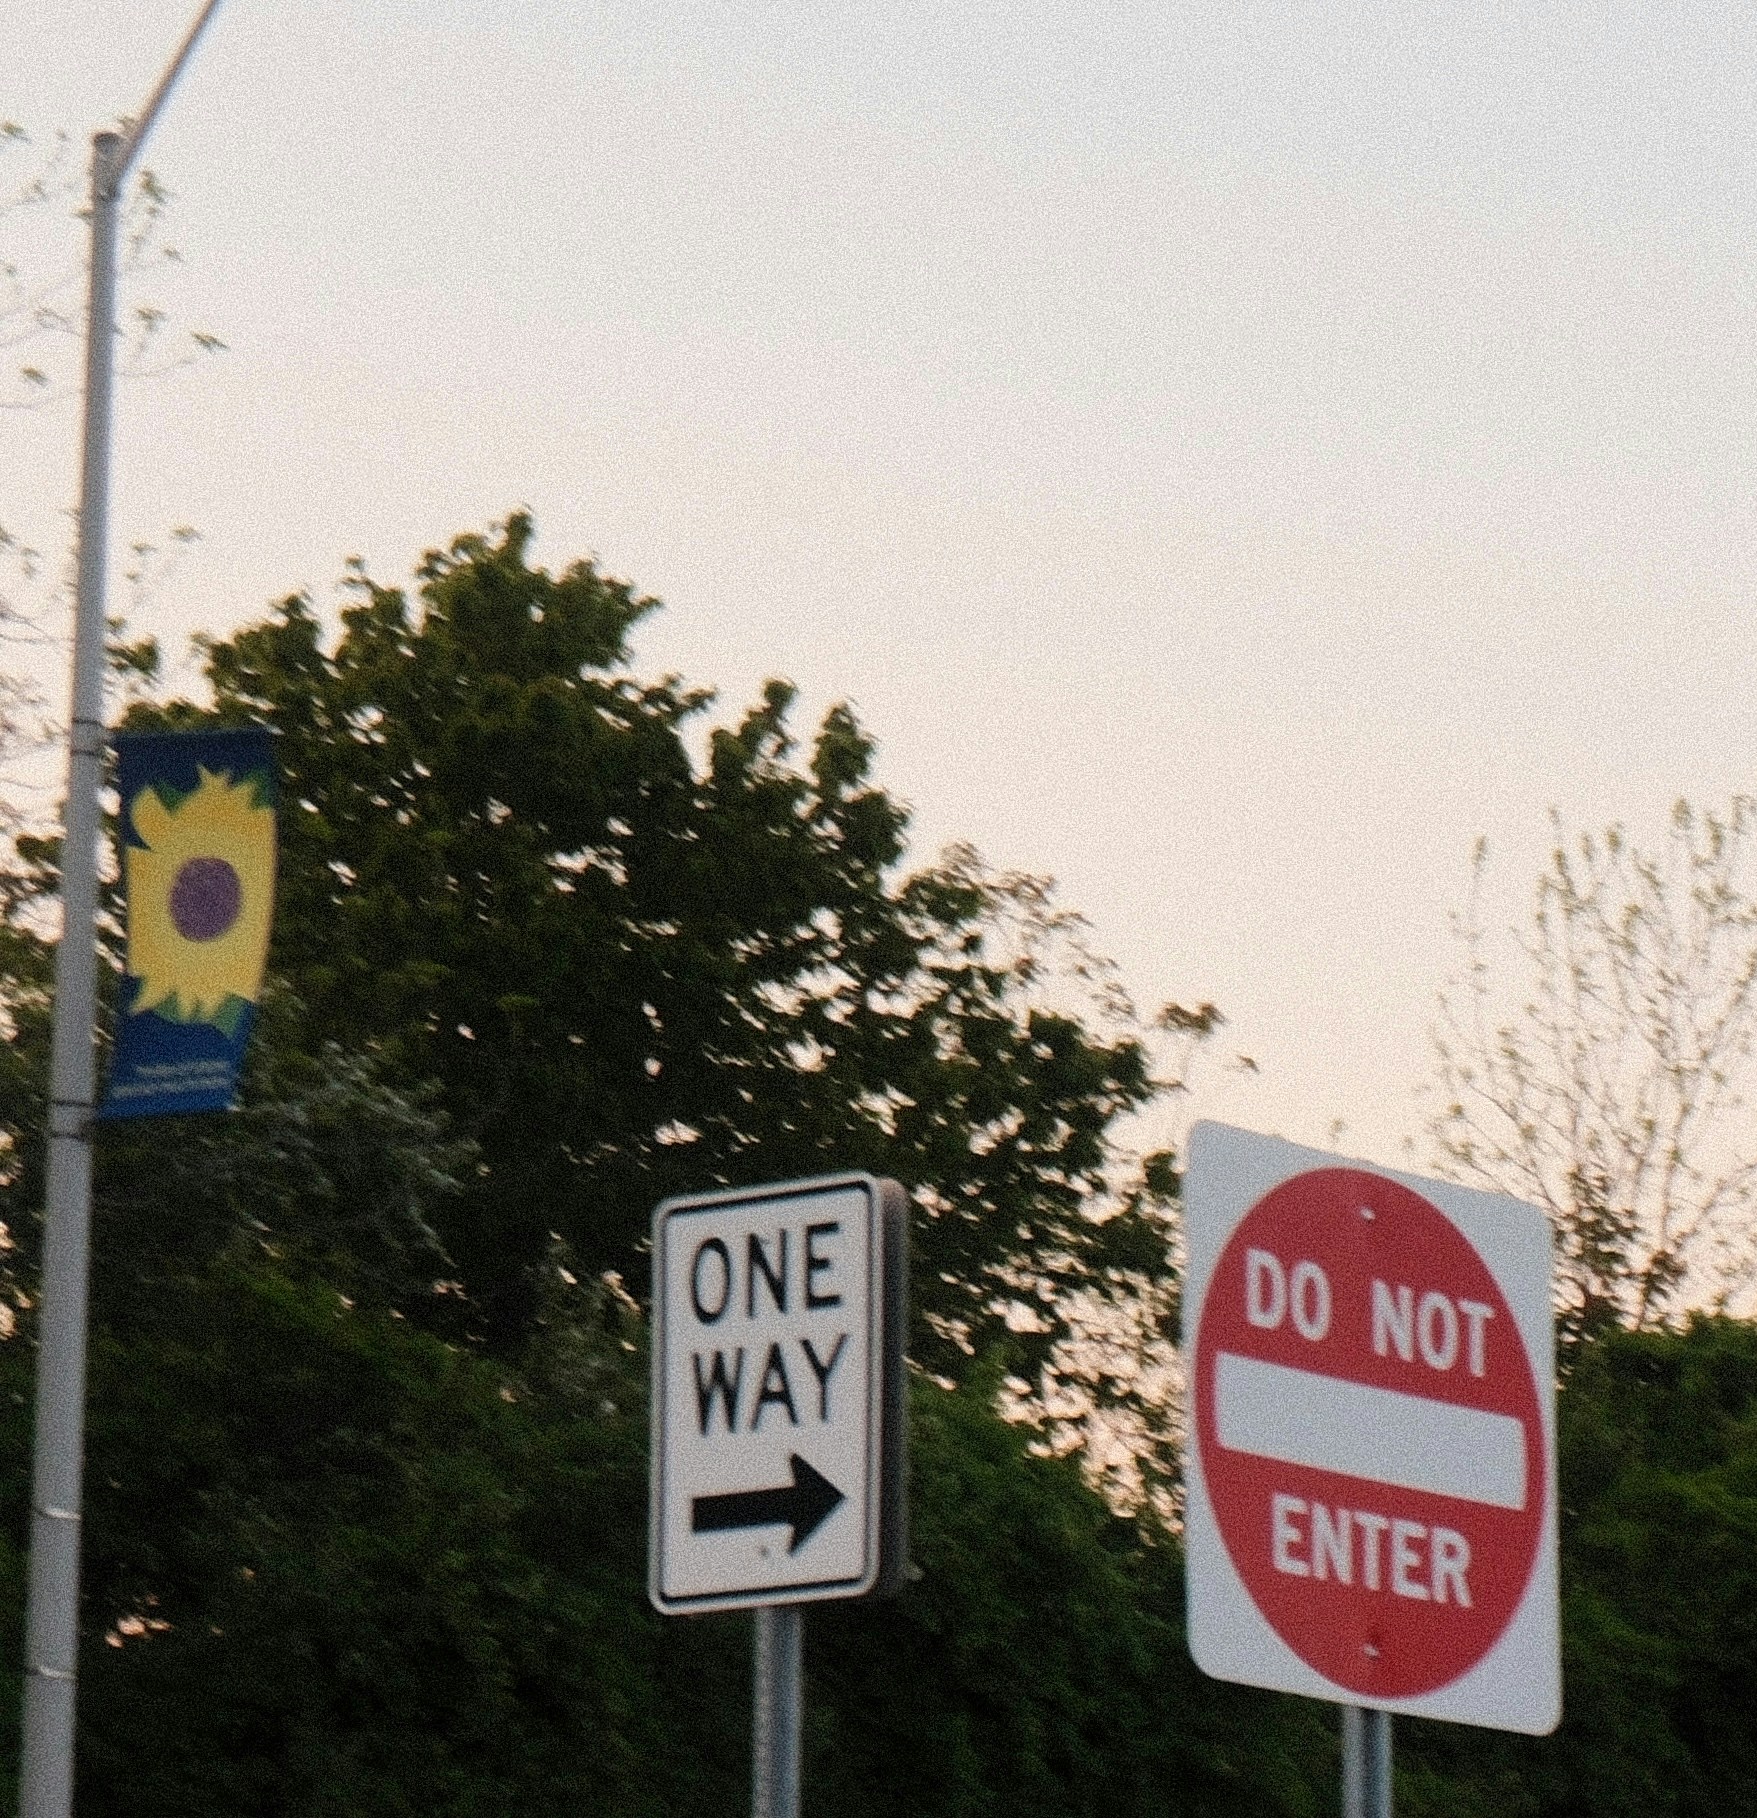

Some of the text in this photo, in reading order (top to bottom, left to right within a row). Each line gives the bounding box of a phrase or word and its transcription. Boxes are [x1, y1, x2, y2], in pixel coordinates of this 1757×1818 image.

[689, 1221, 843, 1326] ONE
[1246, 1248, 1495, 1378] DO NOT
[691, 1333, 848, 1436] WAY
[1271, 1494, 1473, 1608] ENTER
